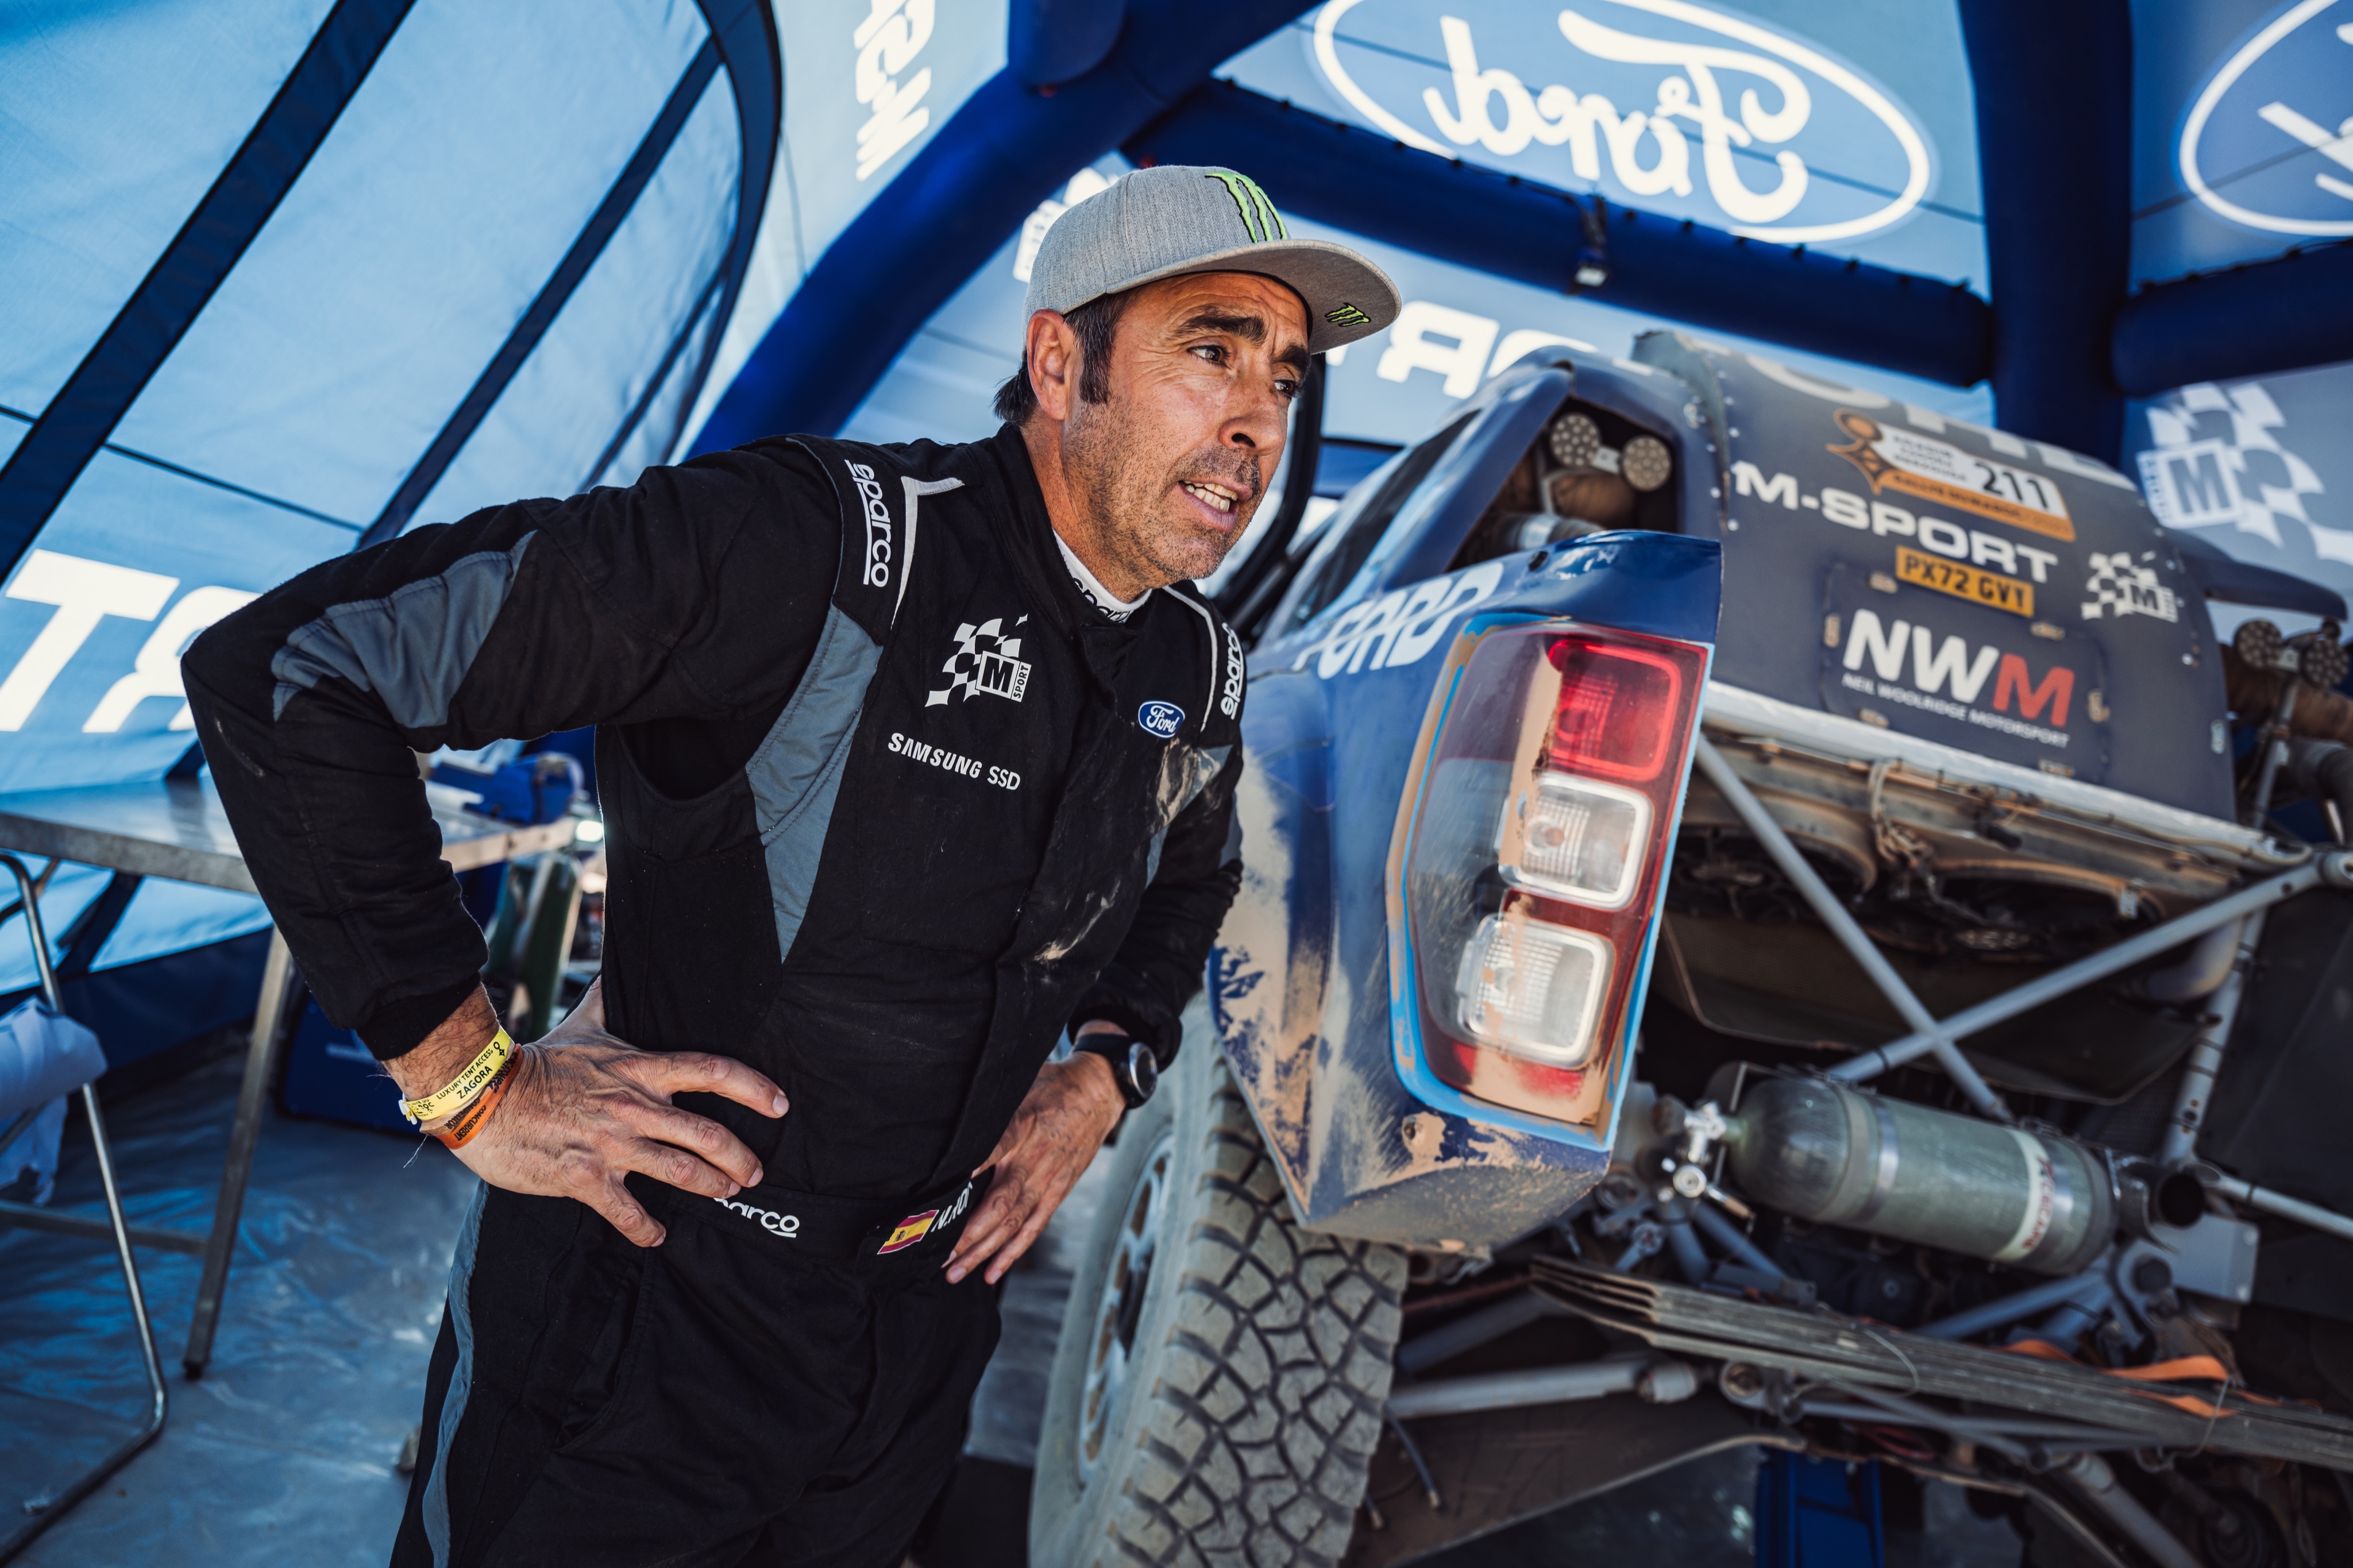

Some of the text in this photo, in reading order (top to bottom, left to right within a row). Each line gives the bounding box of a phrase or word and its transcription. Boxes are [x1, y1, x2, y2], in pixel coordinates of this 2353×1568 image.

[1974, 461, 2049, 511] 211
[1734, 460, 2059, 584] M-SPORT
[1013, 665, 1029, 698] SPORT
[1842, 608, 2076, 729] NWM
[1146, 705, 1180, 733] Ford
[888, 732, 1021, 791] SAMSUNG SSD
[436, 1079, 462, 1100] LUXURY
[461, 1067, 476, 1081] TENT
[456, 1065, 493, 1100] ZAGORA
[454, 1104, 487, 1141] CONCURRENT
